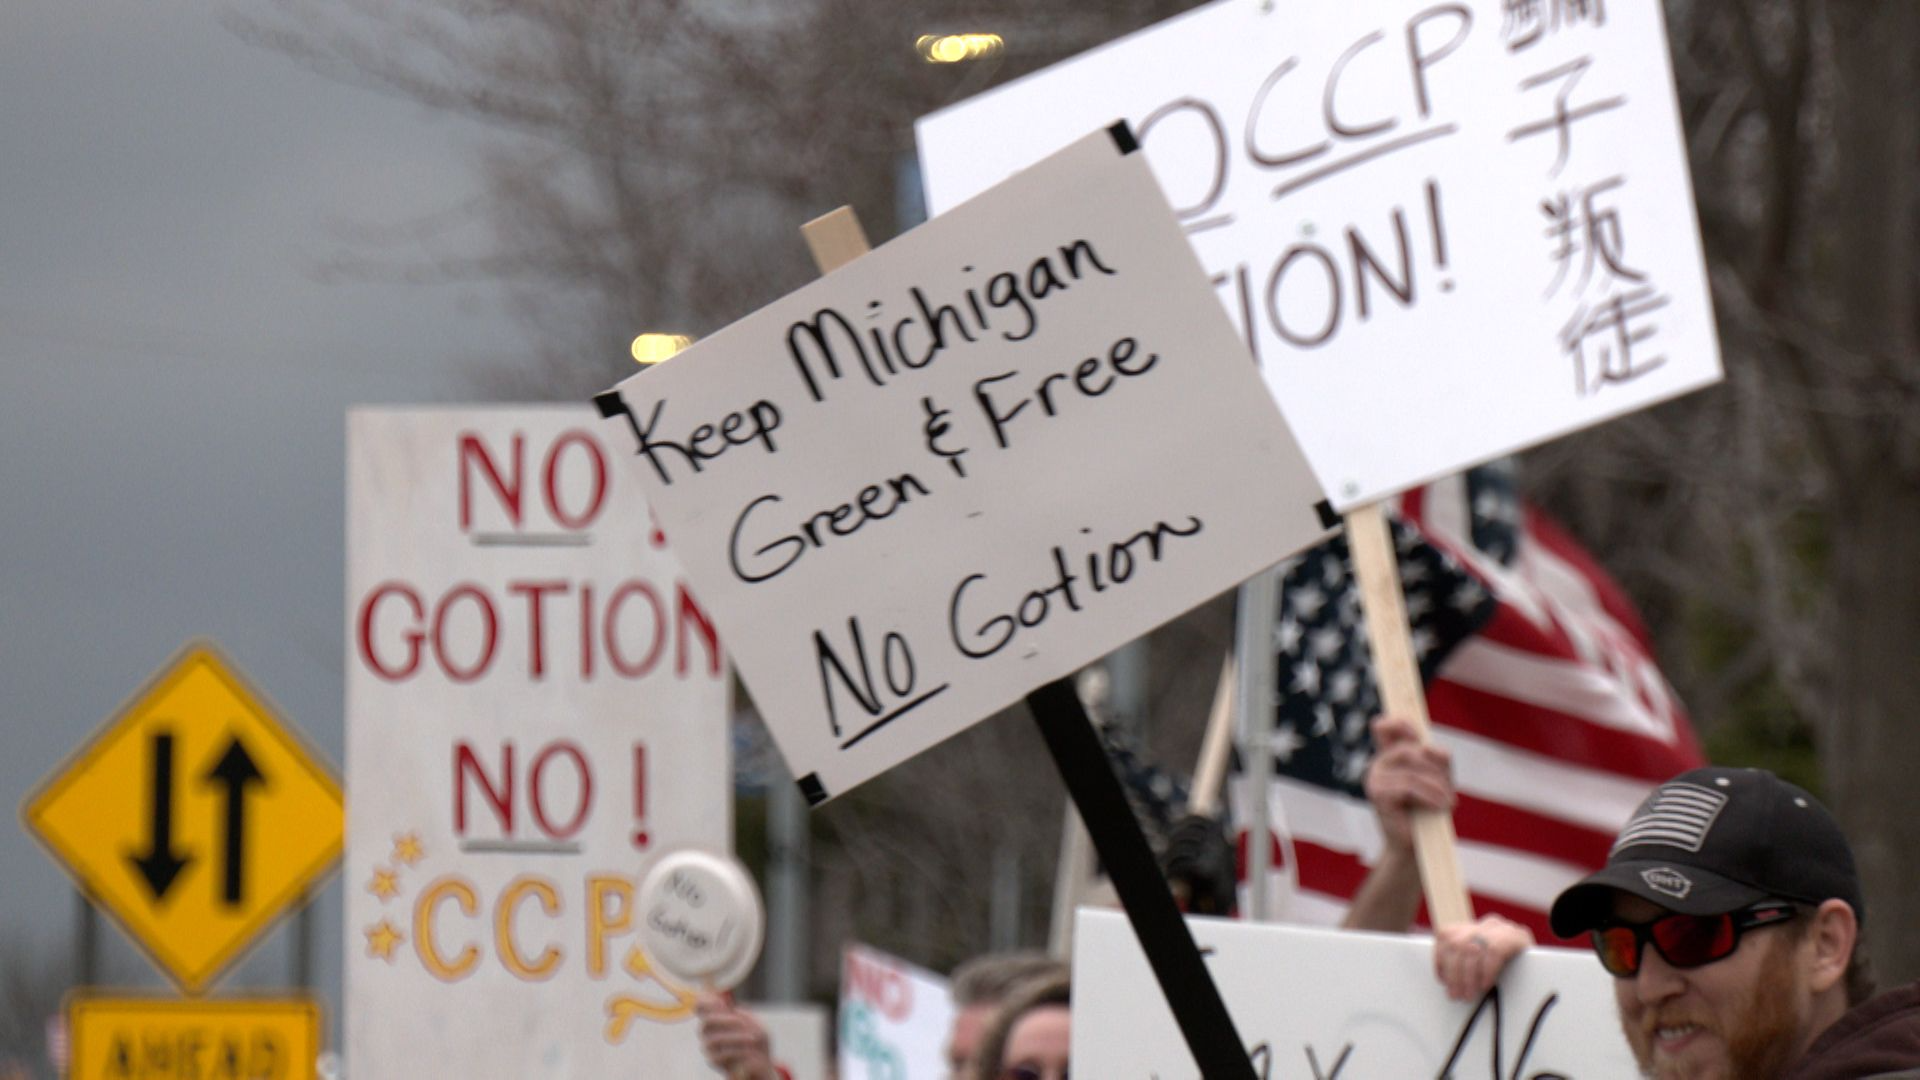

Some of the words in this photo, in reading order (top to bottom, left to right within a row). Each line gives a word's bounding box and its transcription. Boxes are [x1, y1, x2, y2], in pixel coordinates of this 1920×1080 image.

[1244, 3, 1474, 170] CCP
[1212, 178, 1455, 366] ION!
[620, 396, 783, 485] Keep
[786, 238, 1117, 402] Michigan
[729, 473, 930, 583] Green
[918, 397, 970, 478] &
[975, 336, 1158, 449] Free
[357, 577, 724, 684] GOTION
[950, 515, 1203, 658] Gotion
[411, 875, 637, 983] CCP
